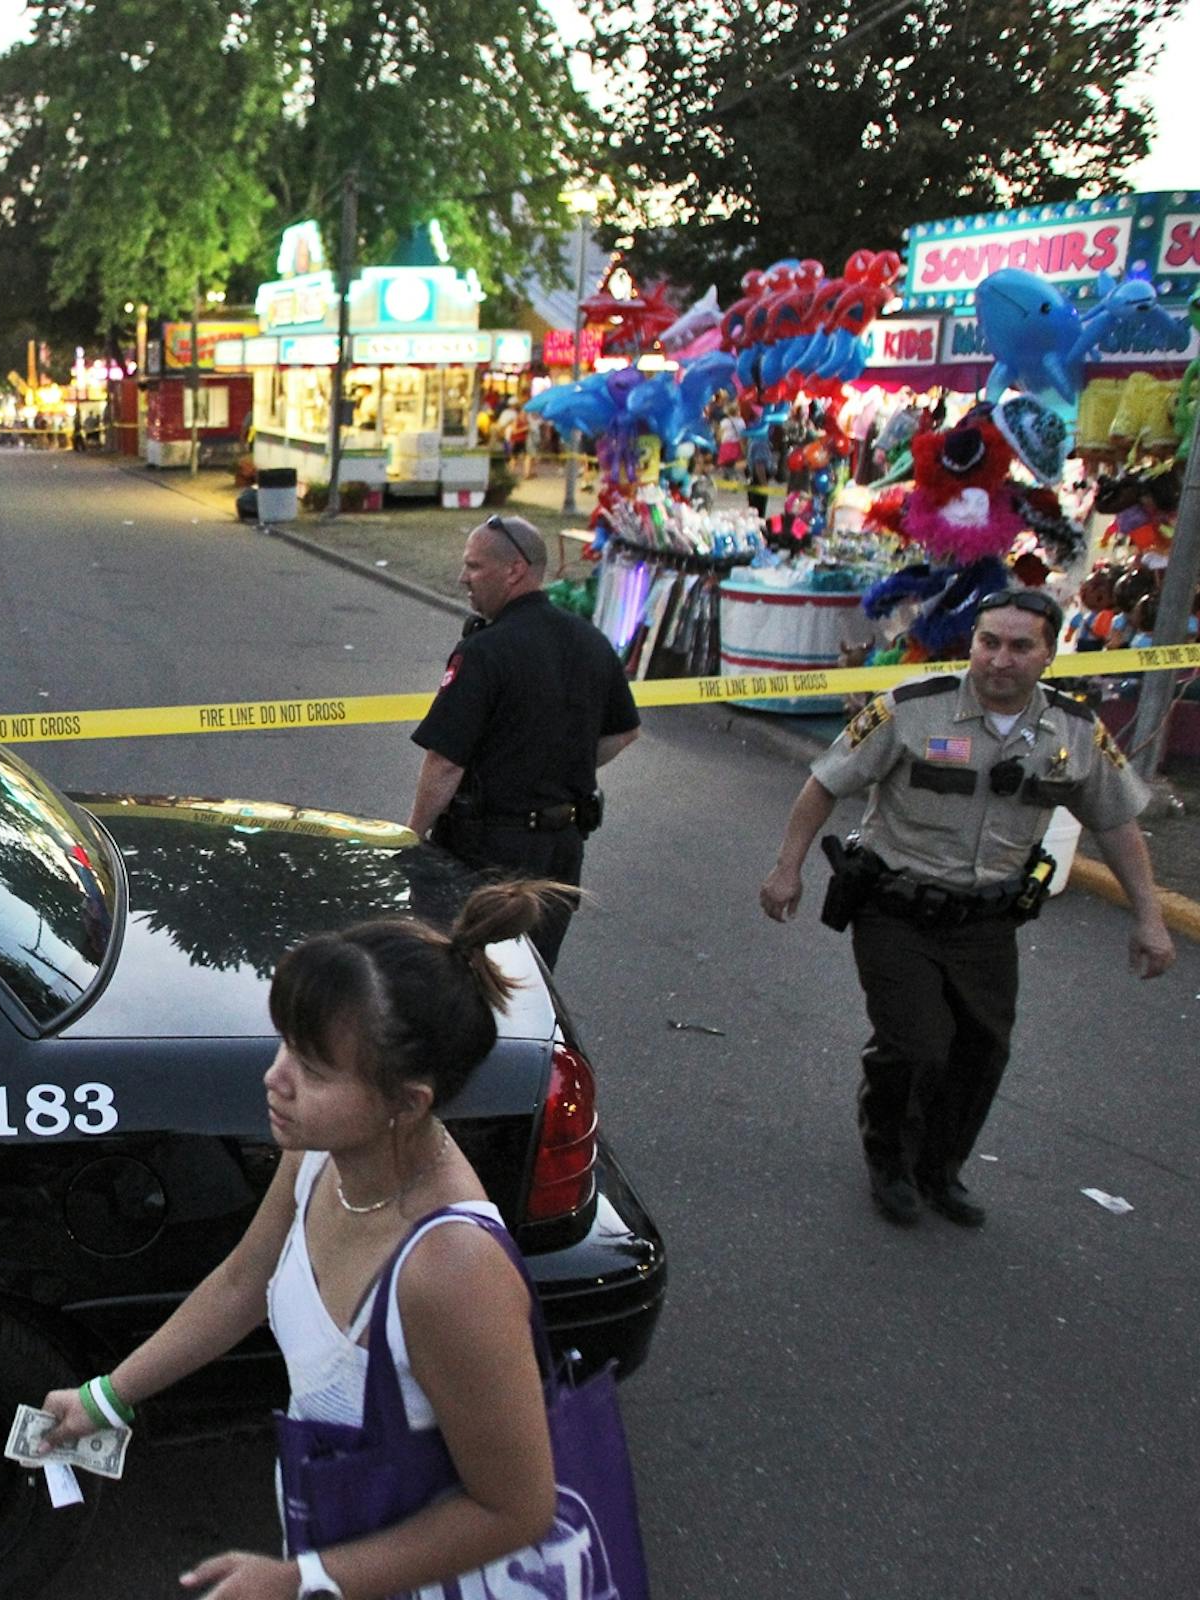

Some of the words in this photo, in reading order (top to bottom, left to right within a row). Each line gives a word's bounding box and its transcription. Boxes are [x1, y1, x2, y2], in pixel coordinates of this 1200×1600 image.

[920, 225, 1122, 285] SOUVENIRS
[698, 679, 722, 699] FIRE
[725, 678, 748, 697] LINE
[752, 676, 767, 695] DO
[769, 675, 789, 694] NOT
[793, 671, 828, 692] CROSS
[12, 718, 36, 738] NOT
[40, 715, 81, 736] CROSS
[199, 707, 226, 728] FIRE
[229, 706, 256, 726] LINE
[260, 705, 276, 724] DO
[280, 703, 303, 723] NOT
[306, 701, 346, 722] CROSS
